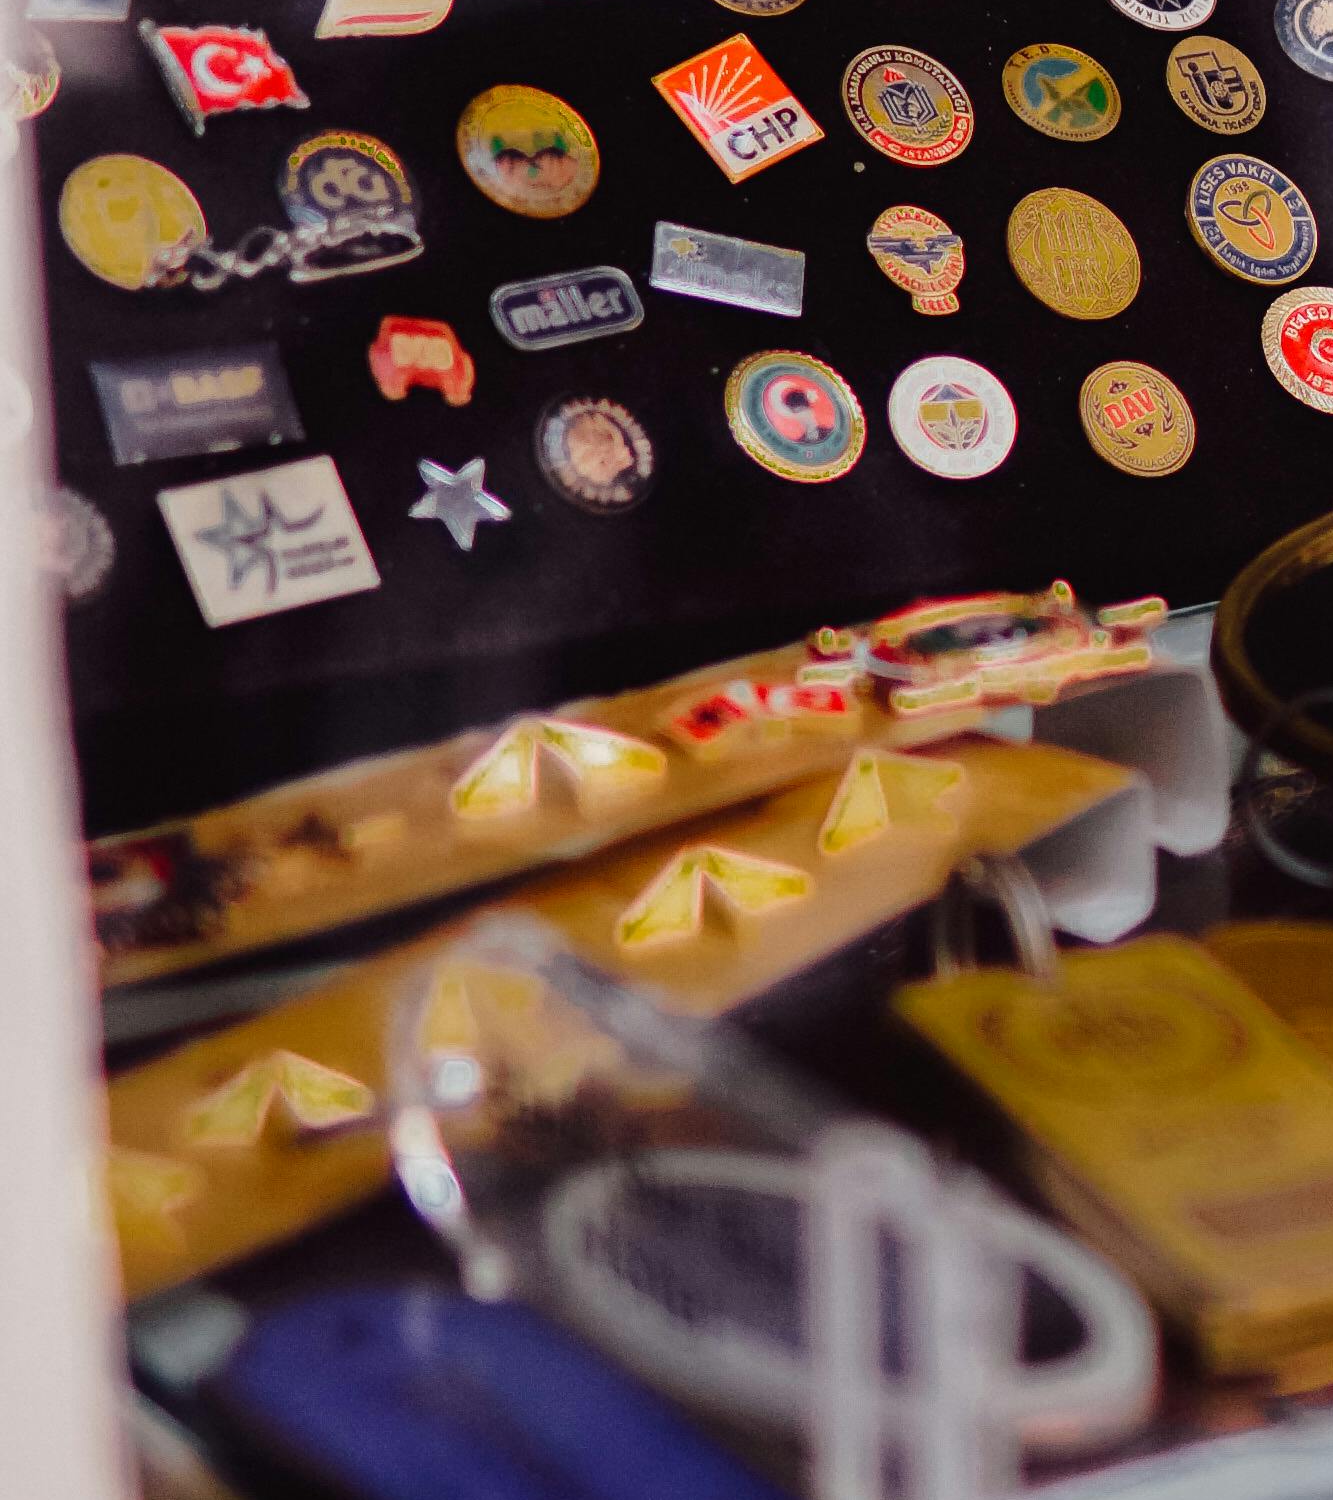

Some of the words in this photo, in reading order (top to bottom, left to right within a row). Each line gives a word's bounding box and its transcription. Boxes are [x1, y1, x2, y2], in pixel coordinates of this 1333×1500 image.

[727, 107, 799, 161] CHP
[1225, 162, 1275, 184] VAKFI
[1103, 386, 1158, 430] DAV
